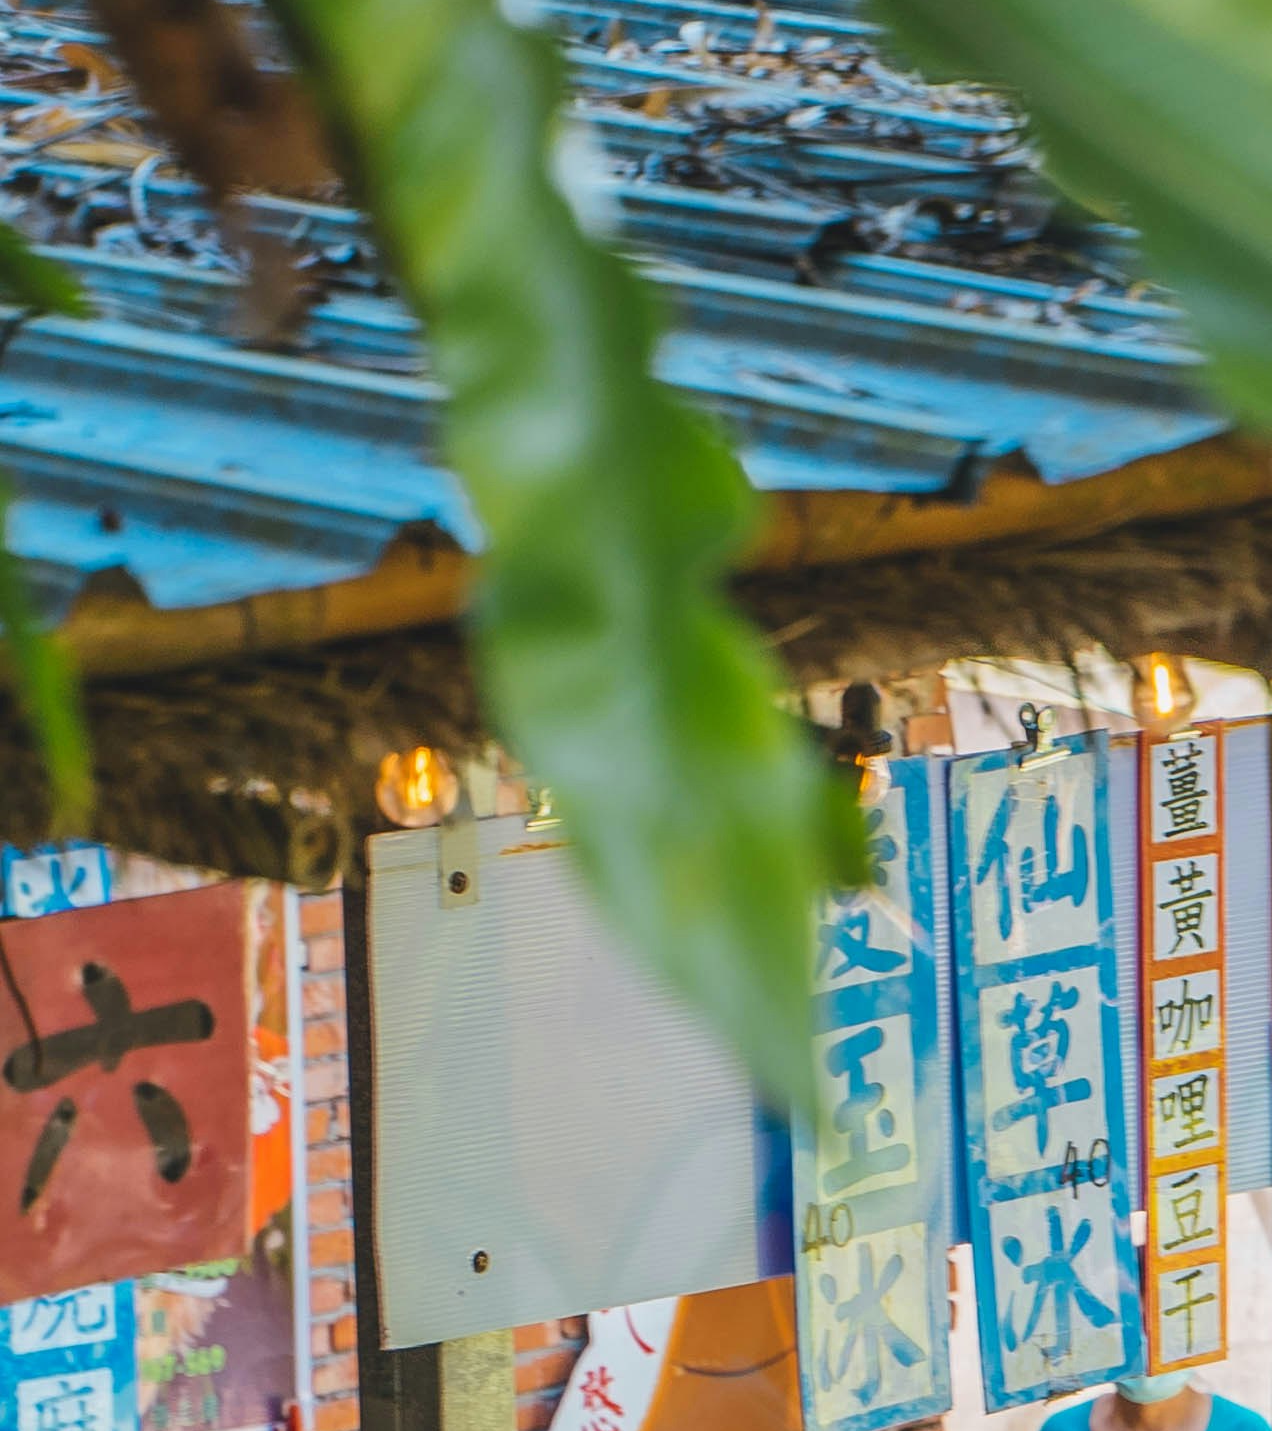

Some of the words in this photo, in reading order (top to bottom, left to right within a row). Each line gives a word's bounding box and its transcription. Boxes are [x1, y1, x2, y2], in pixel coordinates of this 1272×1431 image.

[973, 782, 1115, 1364] 仙草冰
[1062, 1139, 1112, 1199] 40
[1156, 743, 1216, 1357] 薑黃咖哩豆干
[803, 1201, 854, 1261] 40
